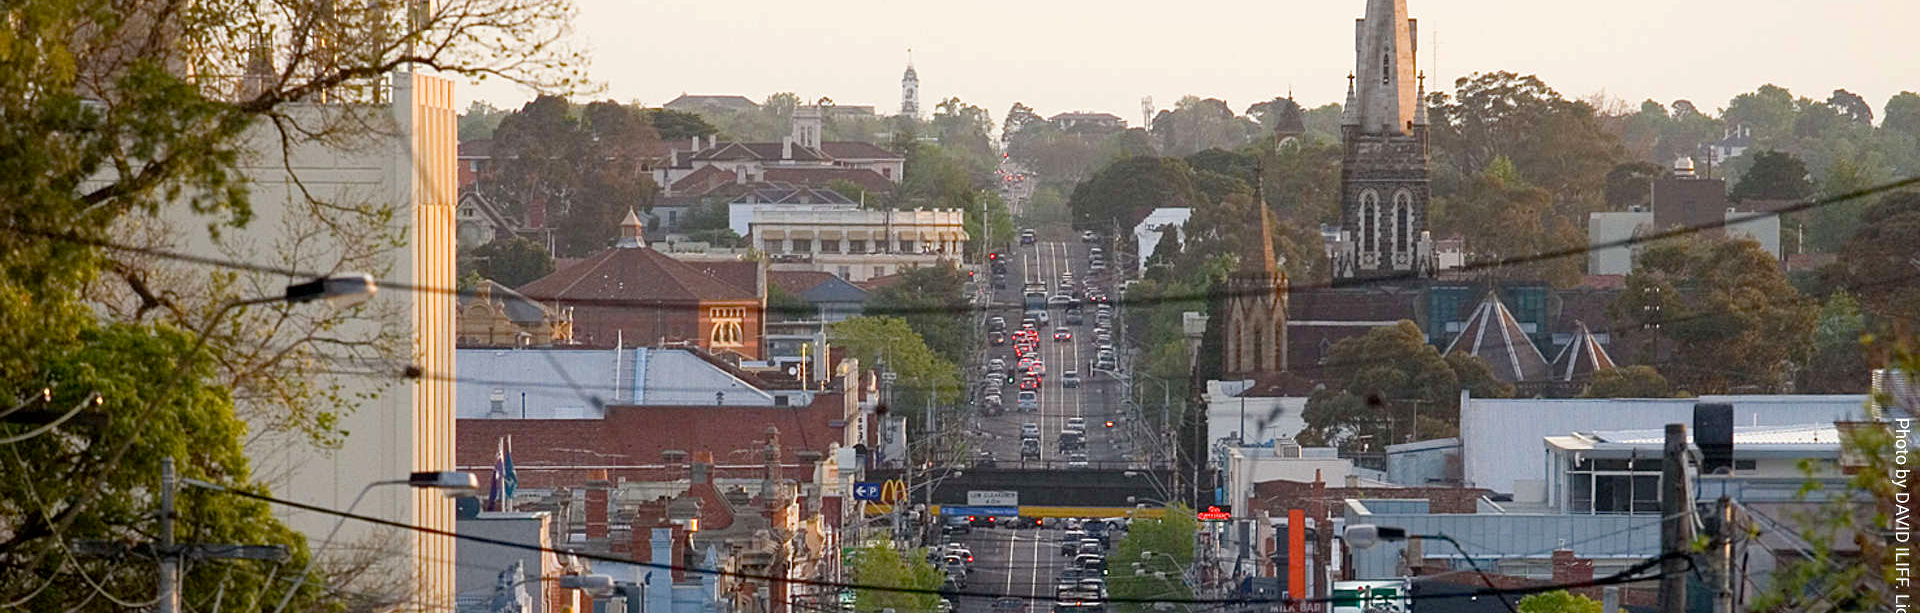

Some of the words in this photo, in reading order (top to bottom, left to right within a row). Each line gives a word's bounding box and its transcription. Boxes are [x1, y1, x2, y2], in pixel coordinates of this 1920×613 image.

[870, 487, 877, 497] P
[1270, 603, 1296, 613] MILK
[1300, 602, 1321, 613] BAR
